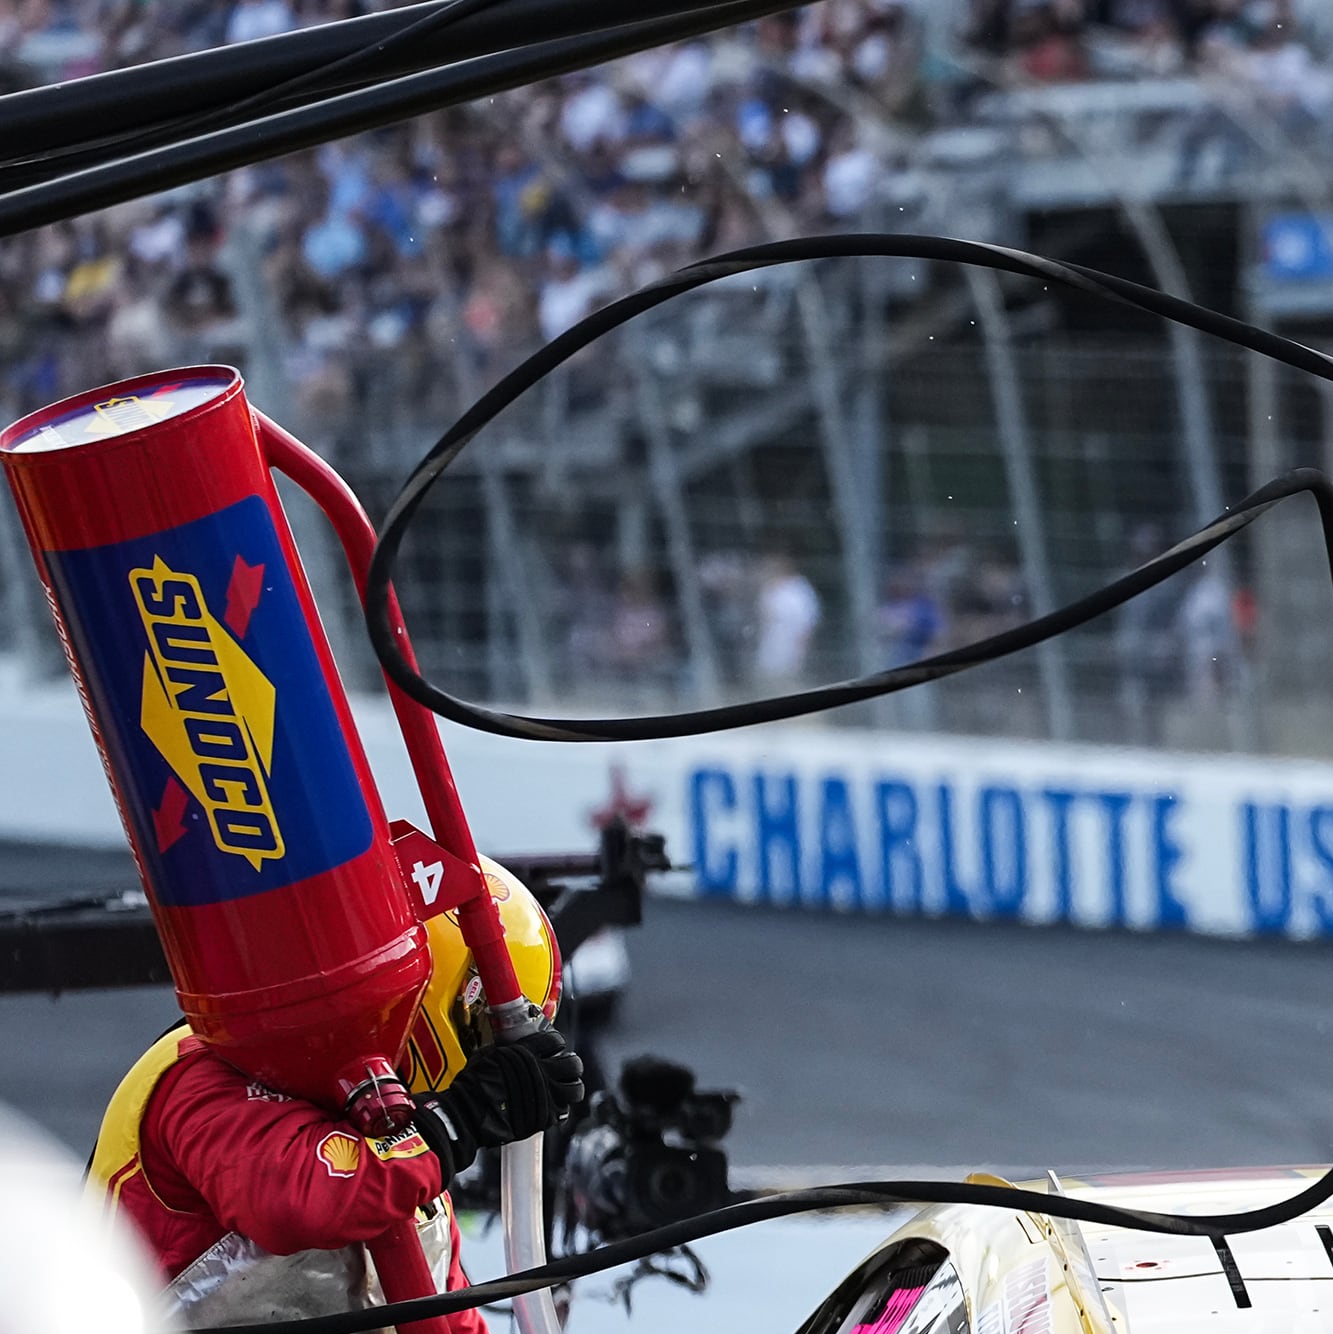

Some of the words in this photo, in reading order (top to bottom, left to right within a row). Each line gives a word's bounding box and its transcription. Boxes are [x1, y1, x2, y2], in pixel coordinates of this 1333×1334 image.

[149, 577, 276, 852] SUNOCO
[411, 861, 444, 905] 4
[690, 766, 1190, 930] CHARLOTTE
